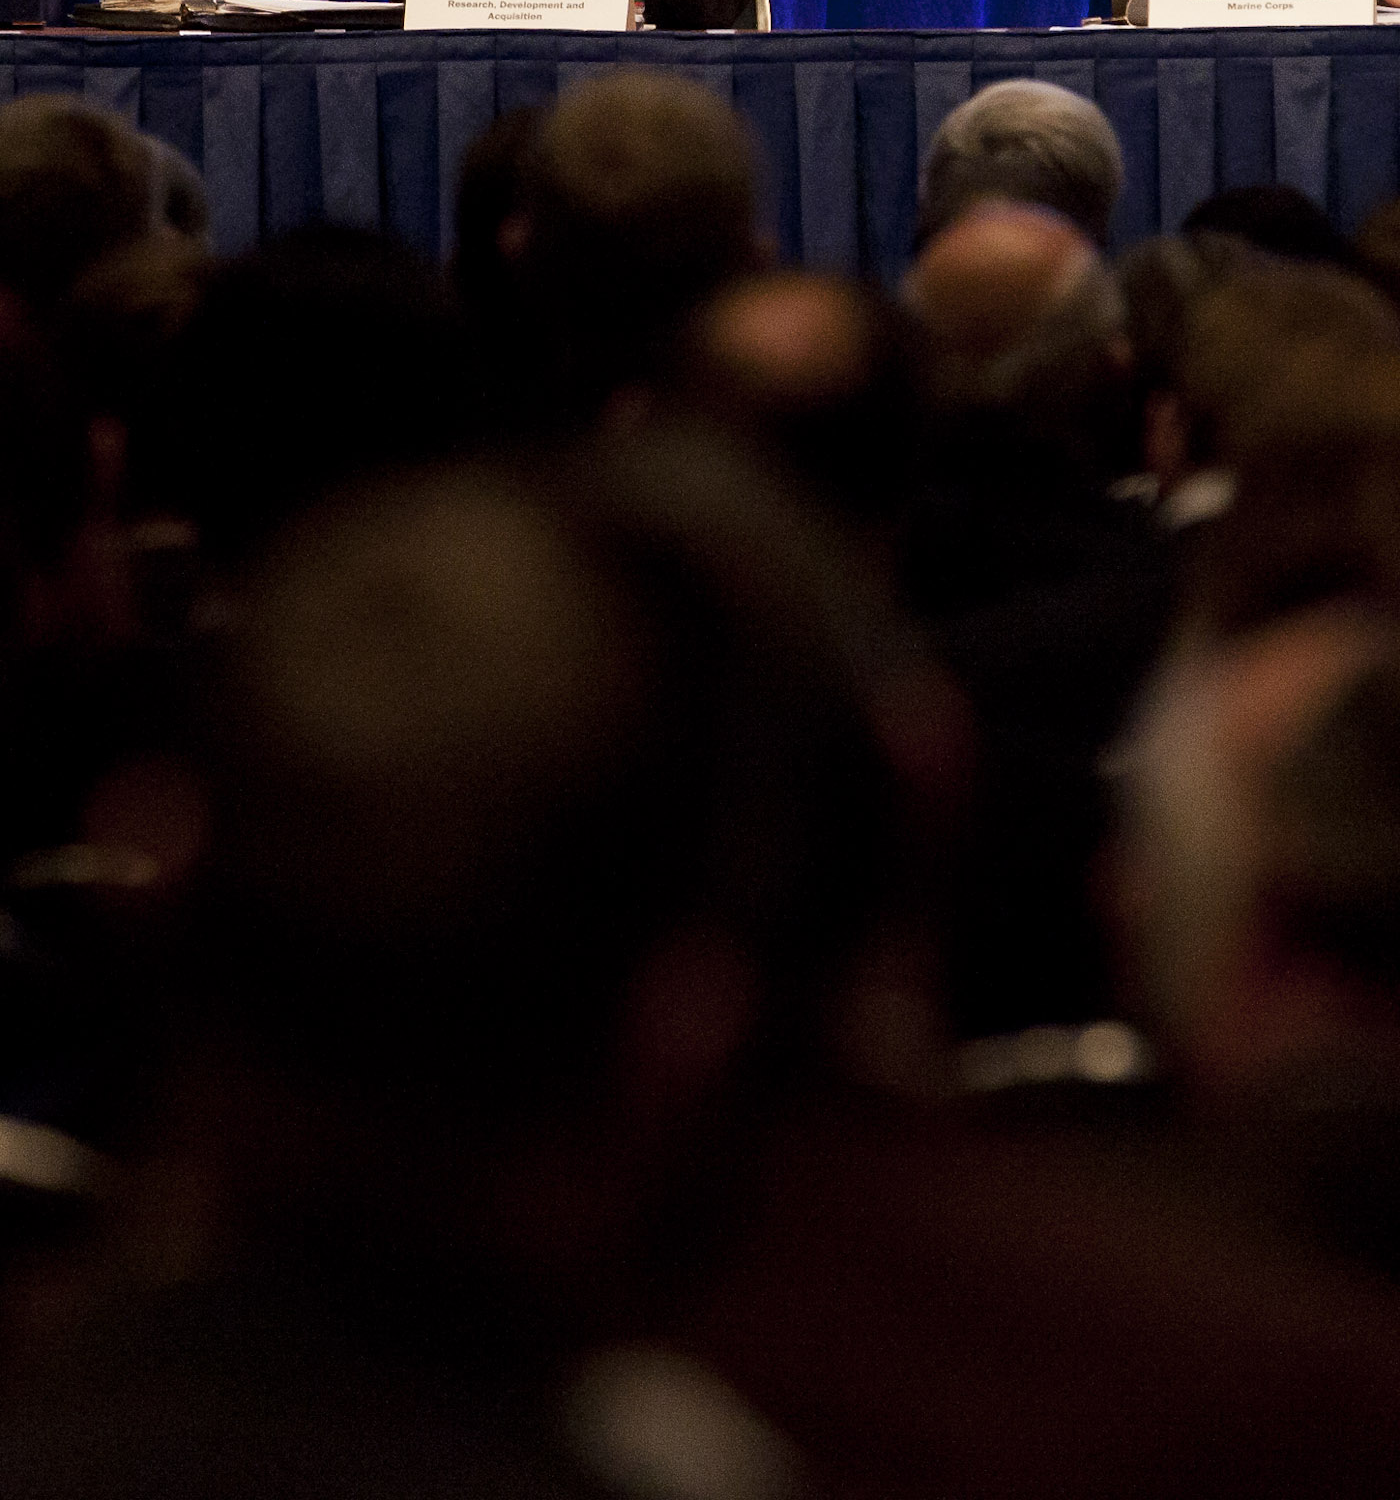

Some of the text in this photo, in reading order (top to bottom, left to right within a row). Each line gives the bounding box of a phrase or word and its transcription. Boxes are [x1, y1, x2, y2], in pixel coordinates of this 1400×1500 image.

[448, 1, 496, 9] Research,
[500, 1, 563, 11] Development
[1265, 2, 1293, 11] Corps
[488, 13, 542, 21] Acquisition
